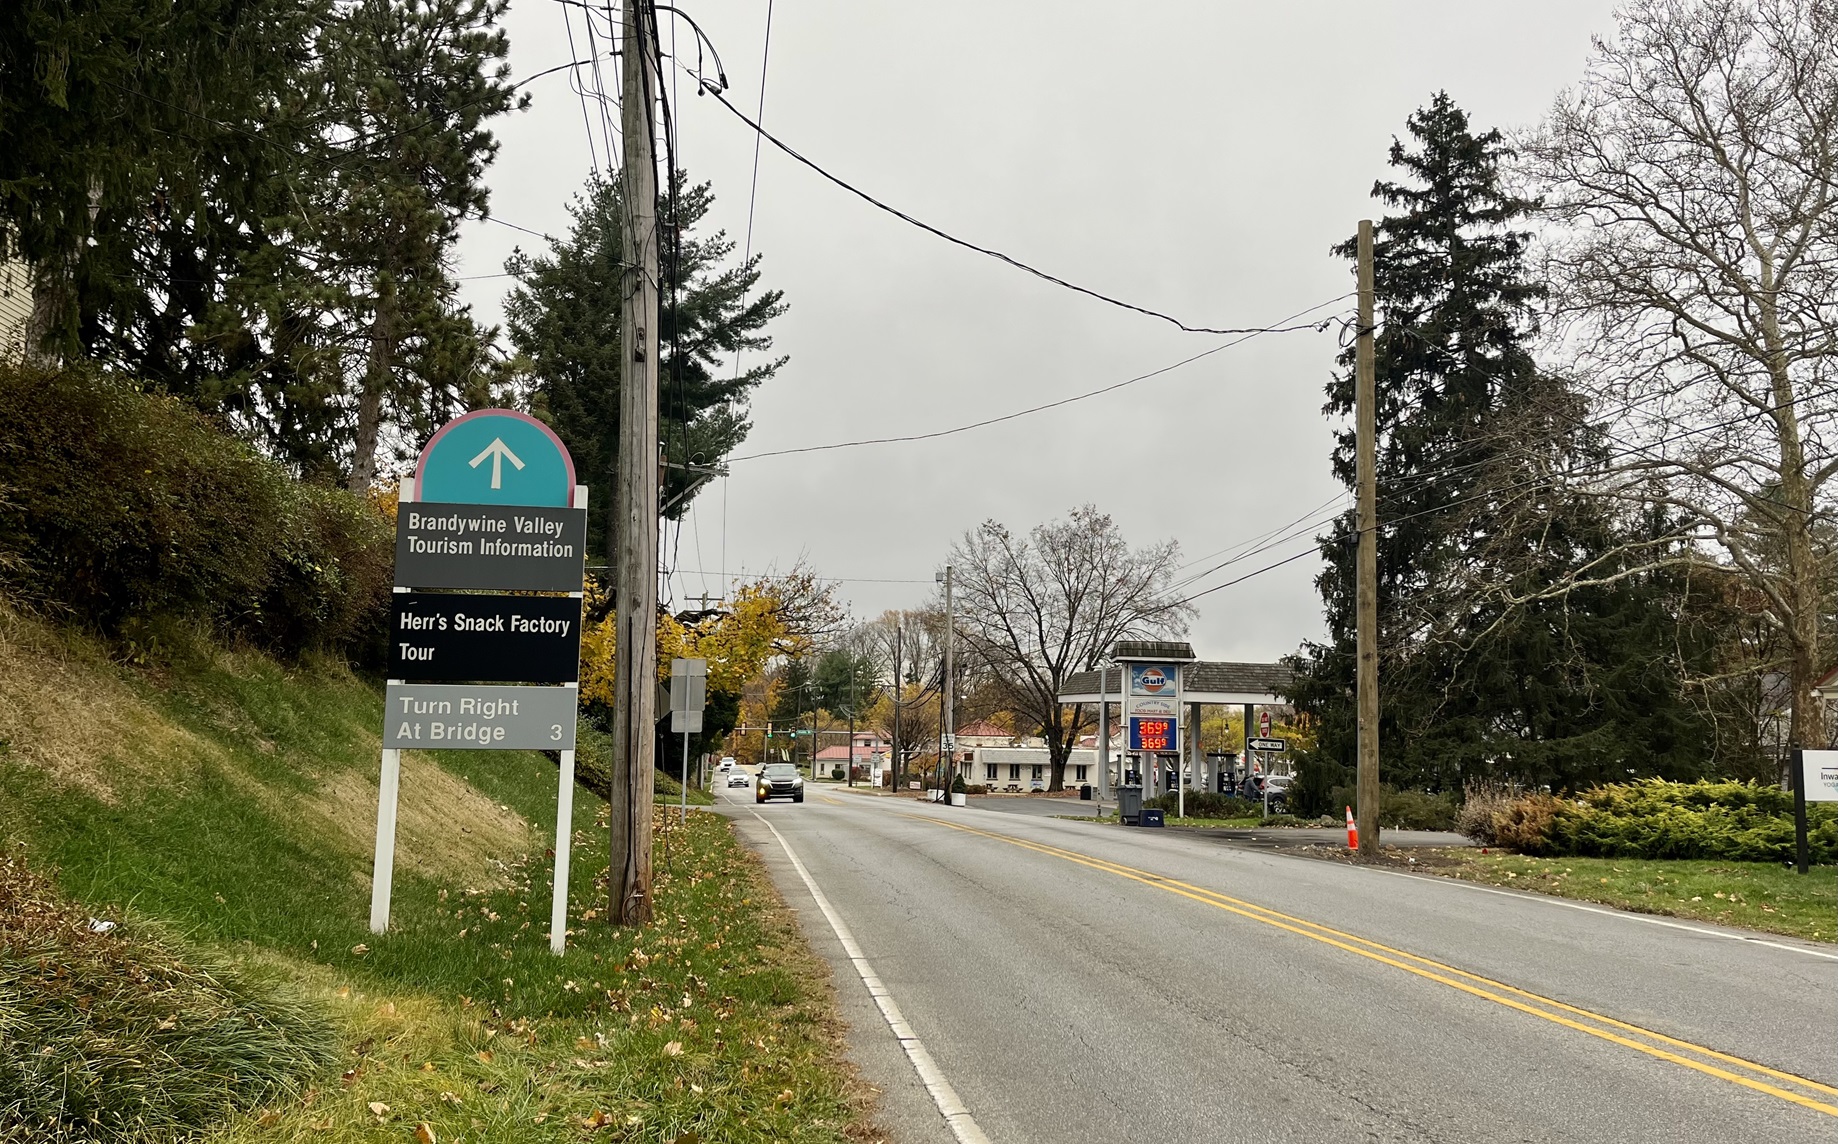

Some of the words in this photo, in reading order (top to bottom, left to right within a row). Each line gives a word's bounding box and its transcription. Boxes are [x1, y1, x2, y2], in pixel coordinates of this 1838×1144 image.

[409, 513, 507, 535] Brandywine
[514, 517, 564, 538] Valley
[407, 535, 473, 555] Tourism
[480, 538, 573, 559] Information
[400, 612, 447, 631] Herr's
[454, 614, 505, 632] Snack
[511, 615, 570, 637] Factory
[399, 643, 435, 661] Tour
[1142, 677, 1165, 685] Gulf
[399, 697, 451, 714] Turn
[460, 698, 519, 720] Right
[397, 722, 421, 739] At
[431, 723, 506, 745] Bridge
[550, 724, 563, 740] 3
